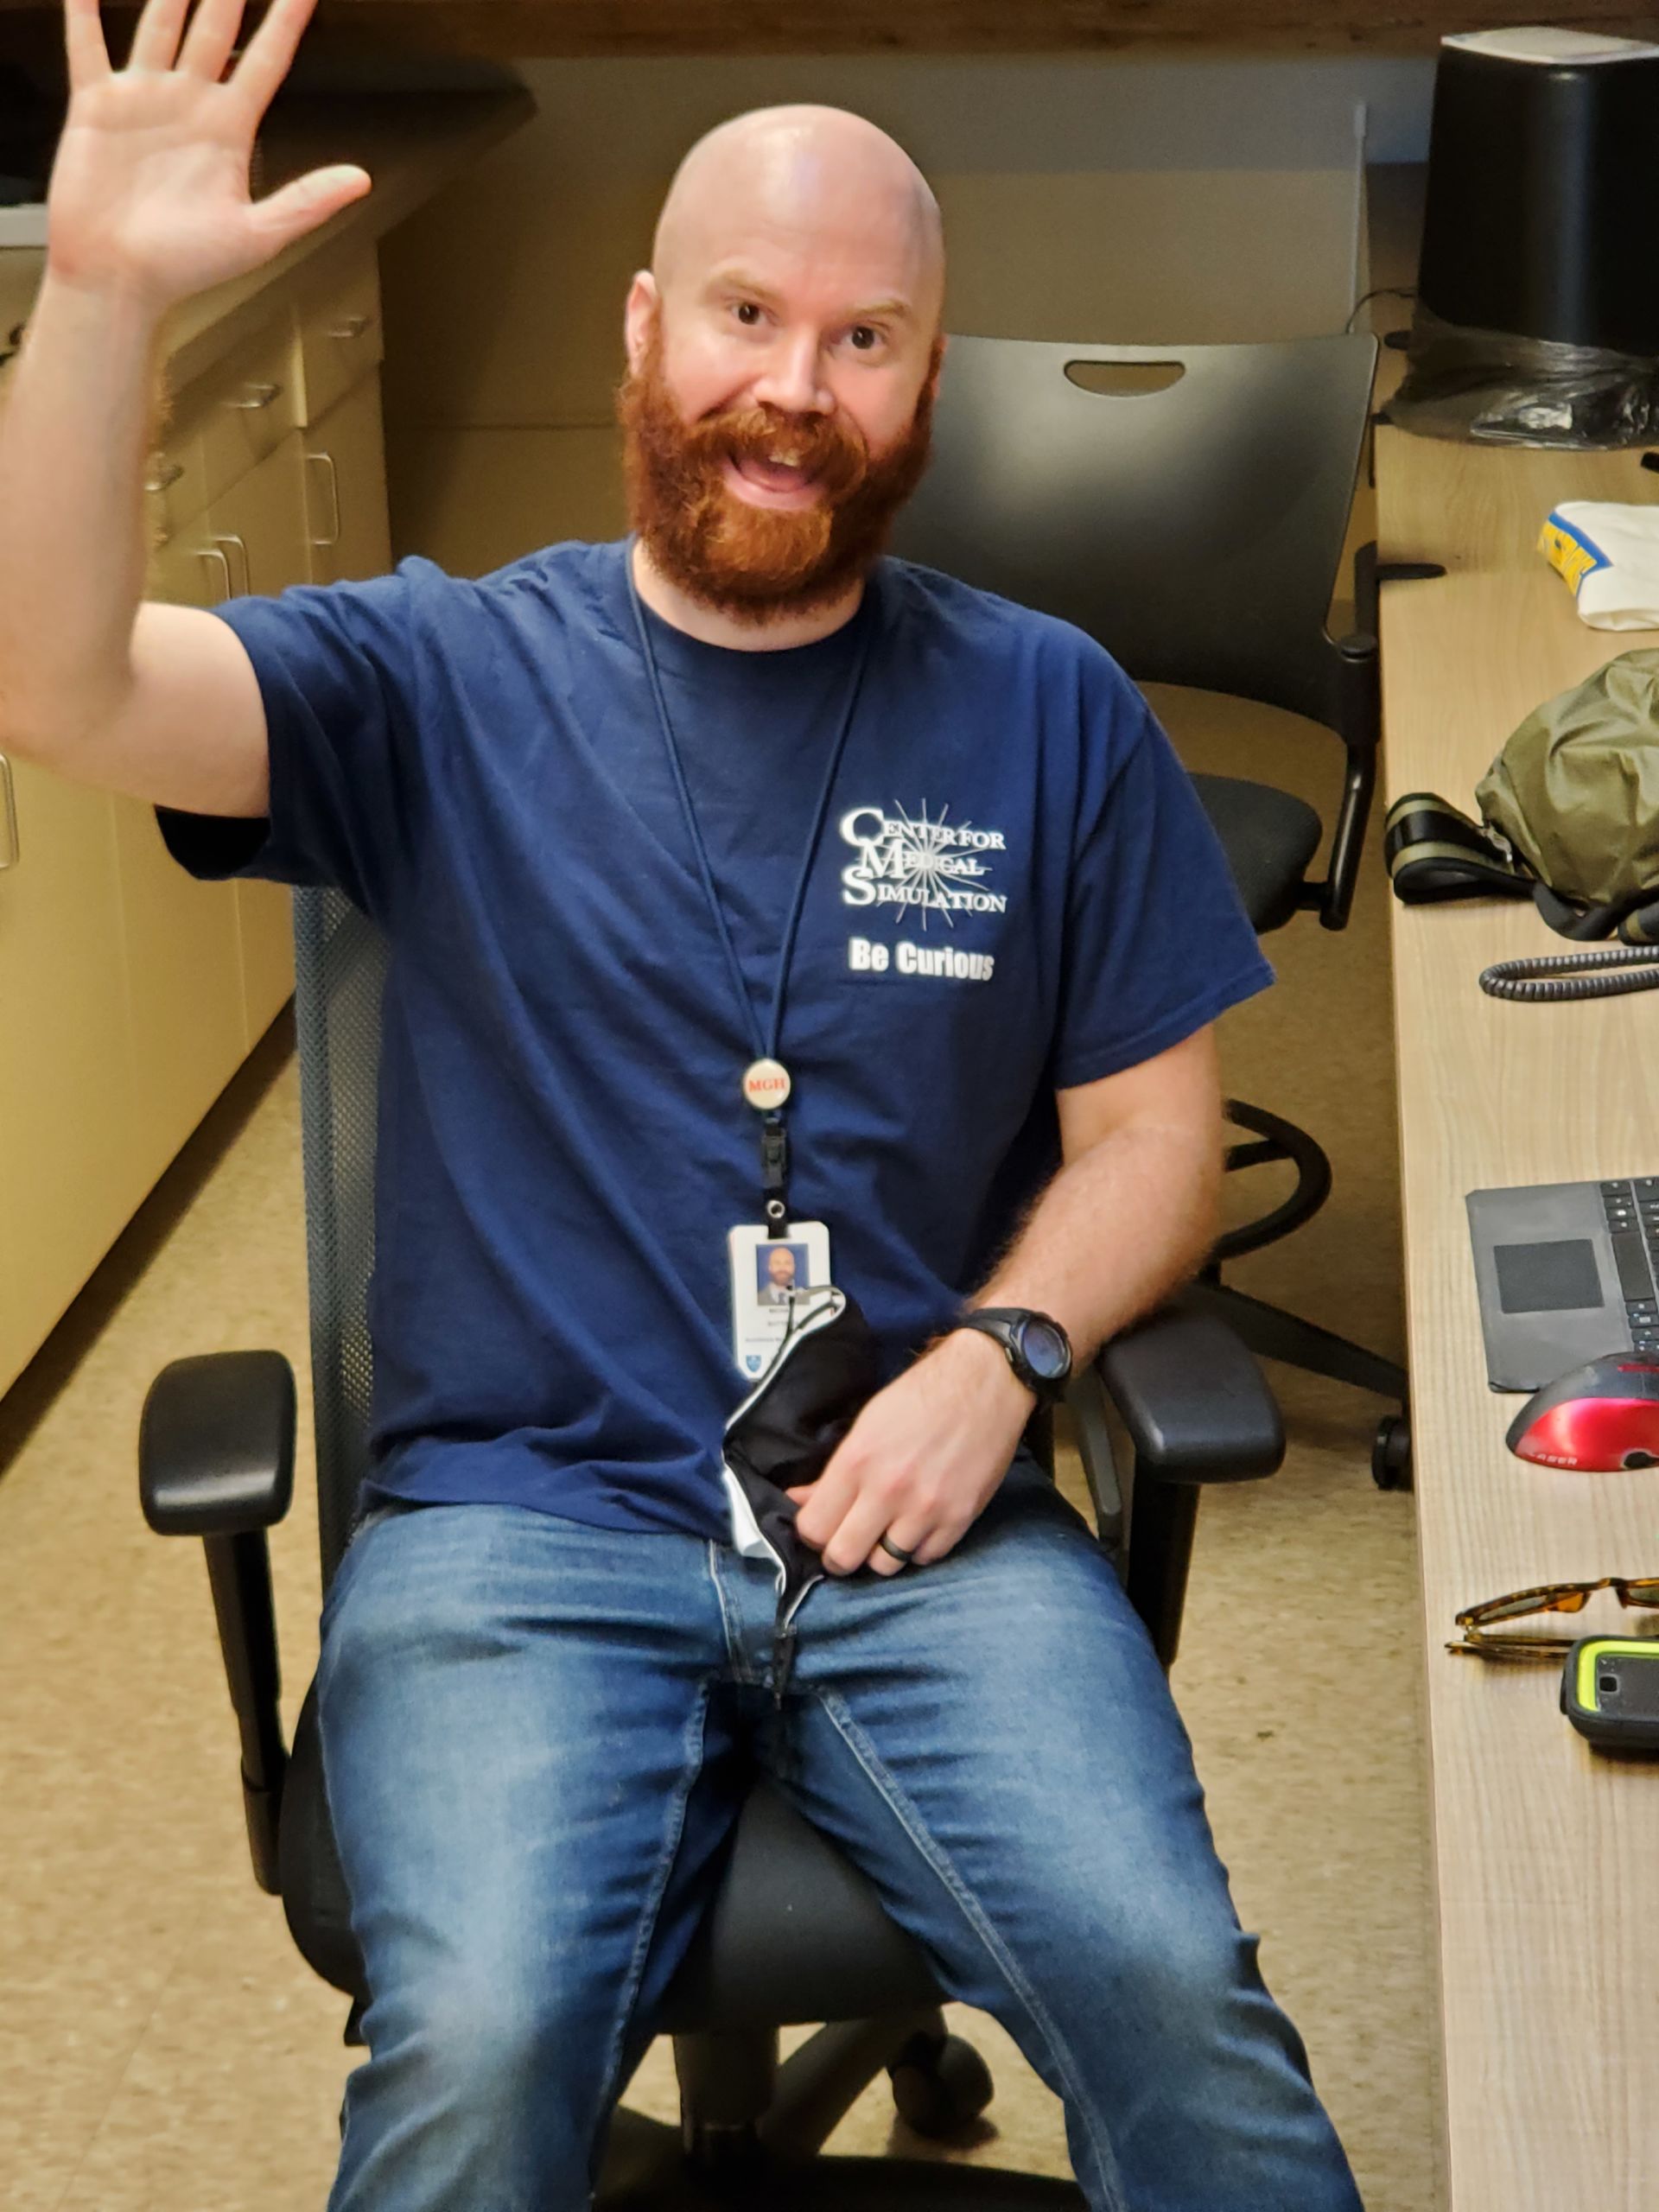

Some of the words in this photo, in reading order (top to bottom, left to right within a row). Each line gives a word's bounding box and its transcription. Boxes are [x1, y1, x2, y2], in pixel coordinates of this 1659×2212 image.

[841, 807, 957, 847] CENTER
[959, 828, 1007, 850] FOR
[859, 837, 985, 880] MEDICAL
[842, 865, 1007, 913] SIMULATION
[849, 936, 889, 972] Be
[896, 941, 995, 982] Curious
[749, 1078, 785, 1092] MGH
